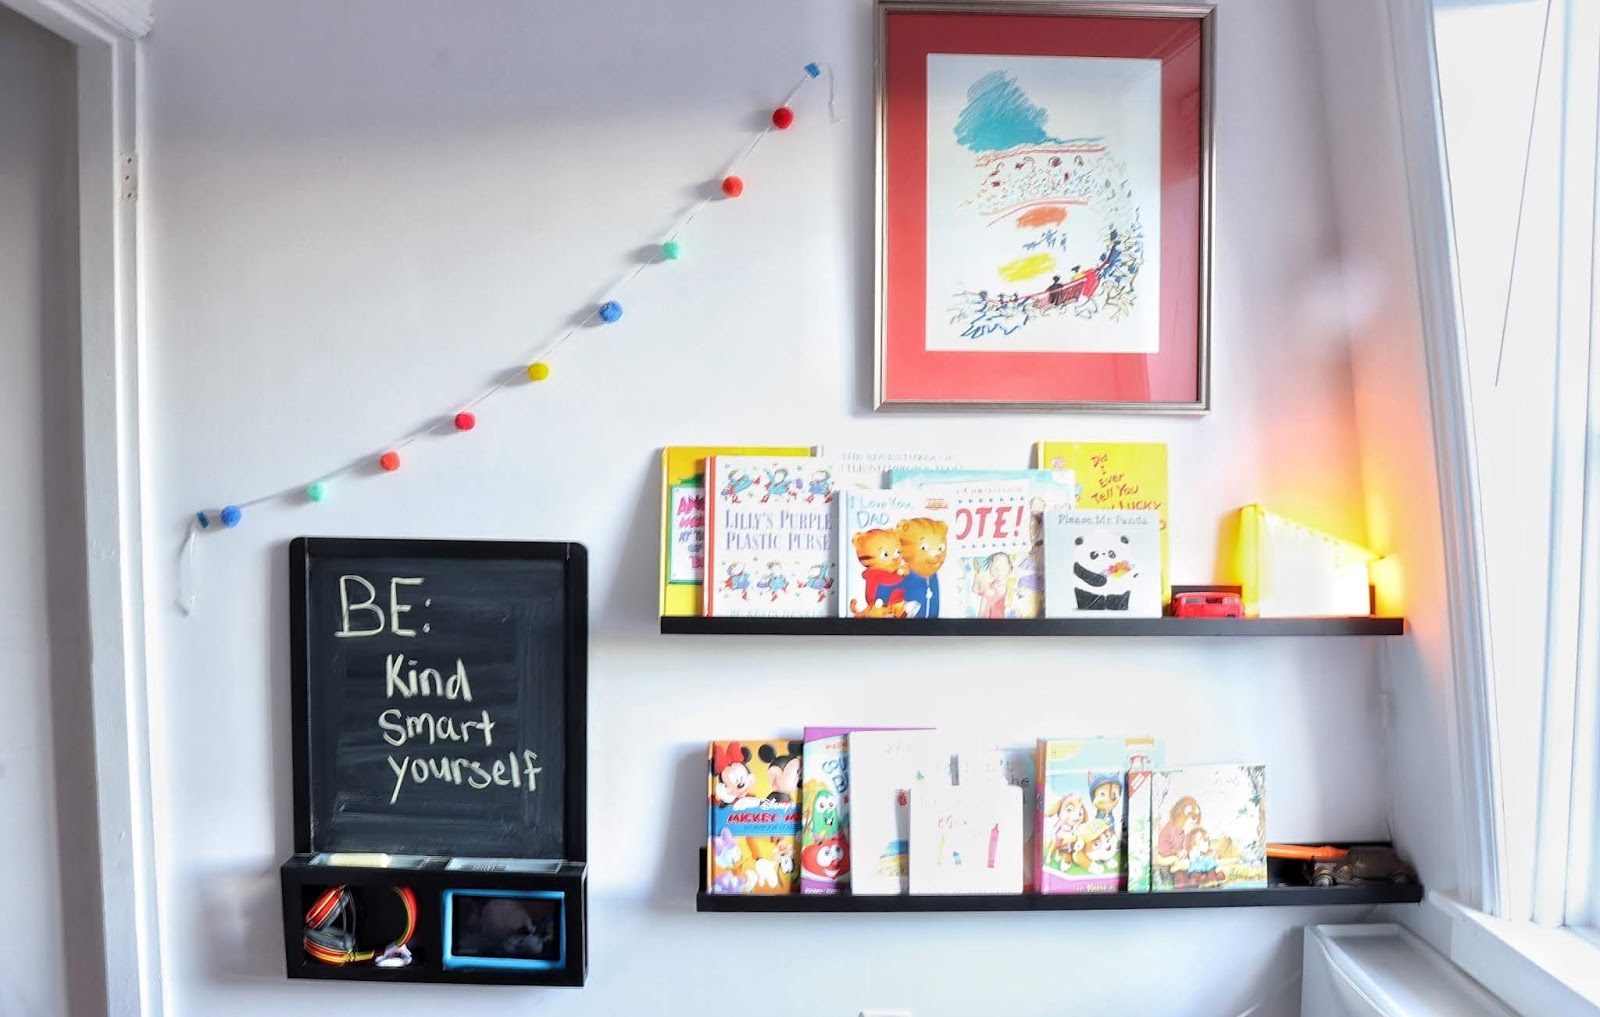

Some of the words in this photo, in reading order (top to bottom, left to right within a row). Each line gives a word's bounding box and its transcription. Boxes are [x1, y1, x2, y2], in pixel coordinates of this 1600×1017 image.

[724, 508, 774, 530] LILLY'S
[779, 508, 833, 530] PURPLE
[955, 504, 1025, 540] OTE!
[725, 531, 782, 552] PLASTIC
[786, 531, 832, 552] PURSE
[333, 575, 431, 638] BE:
[385, 653, 473, 702] Kind
[377, 708, 496, 747] Smart
[387, 749, 543, 806] yourself
[727, 812, 777, 825] MICKEY
